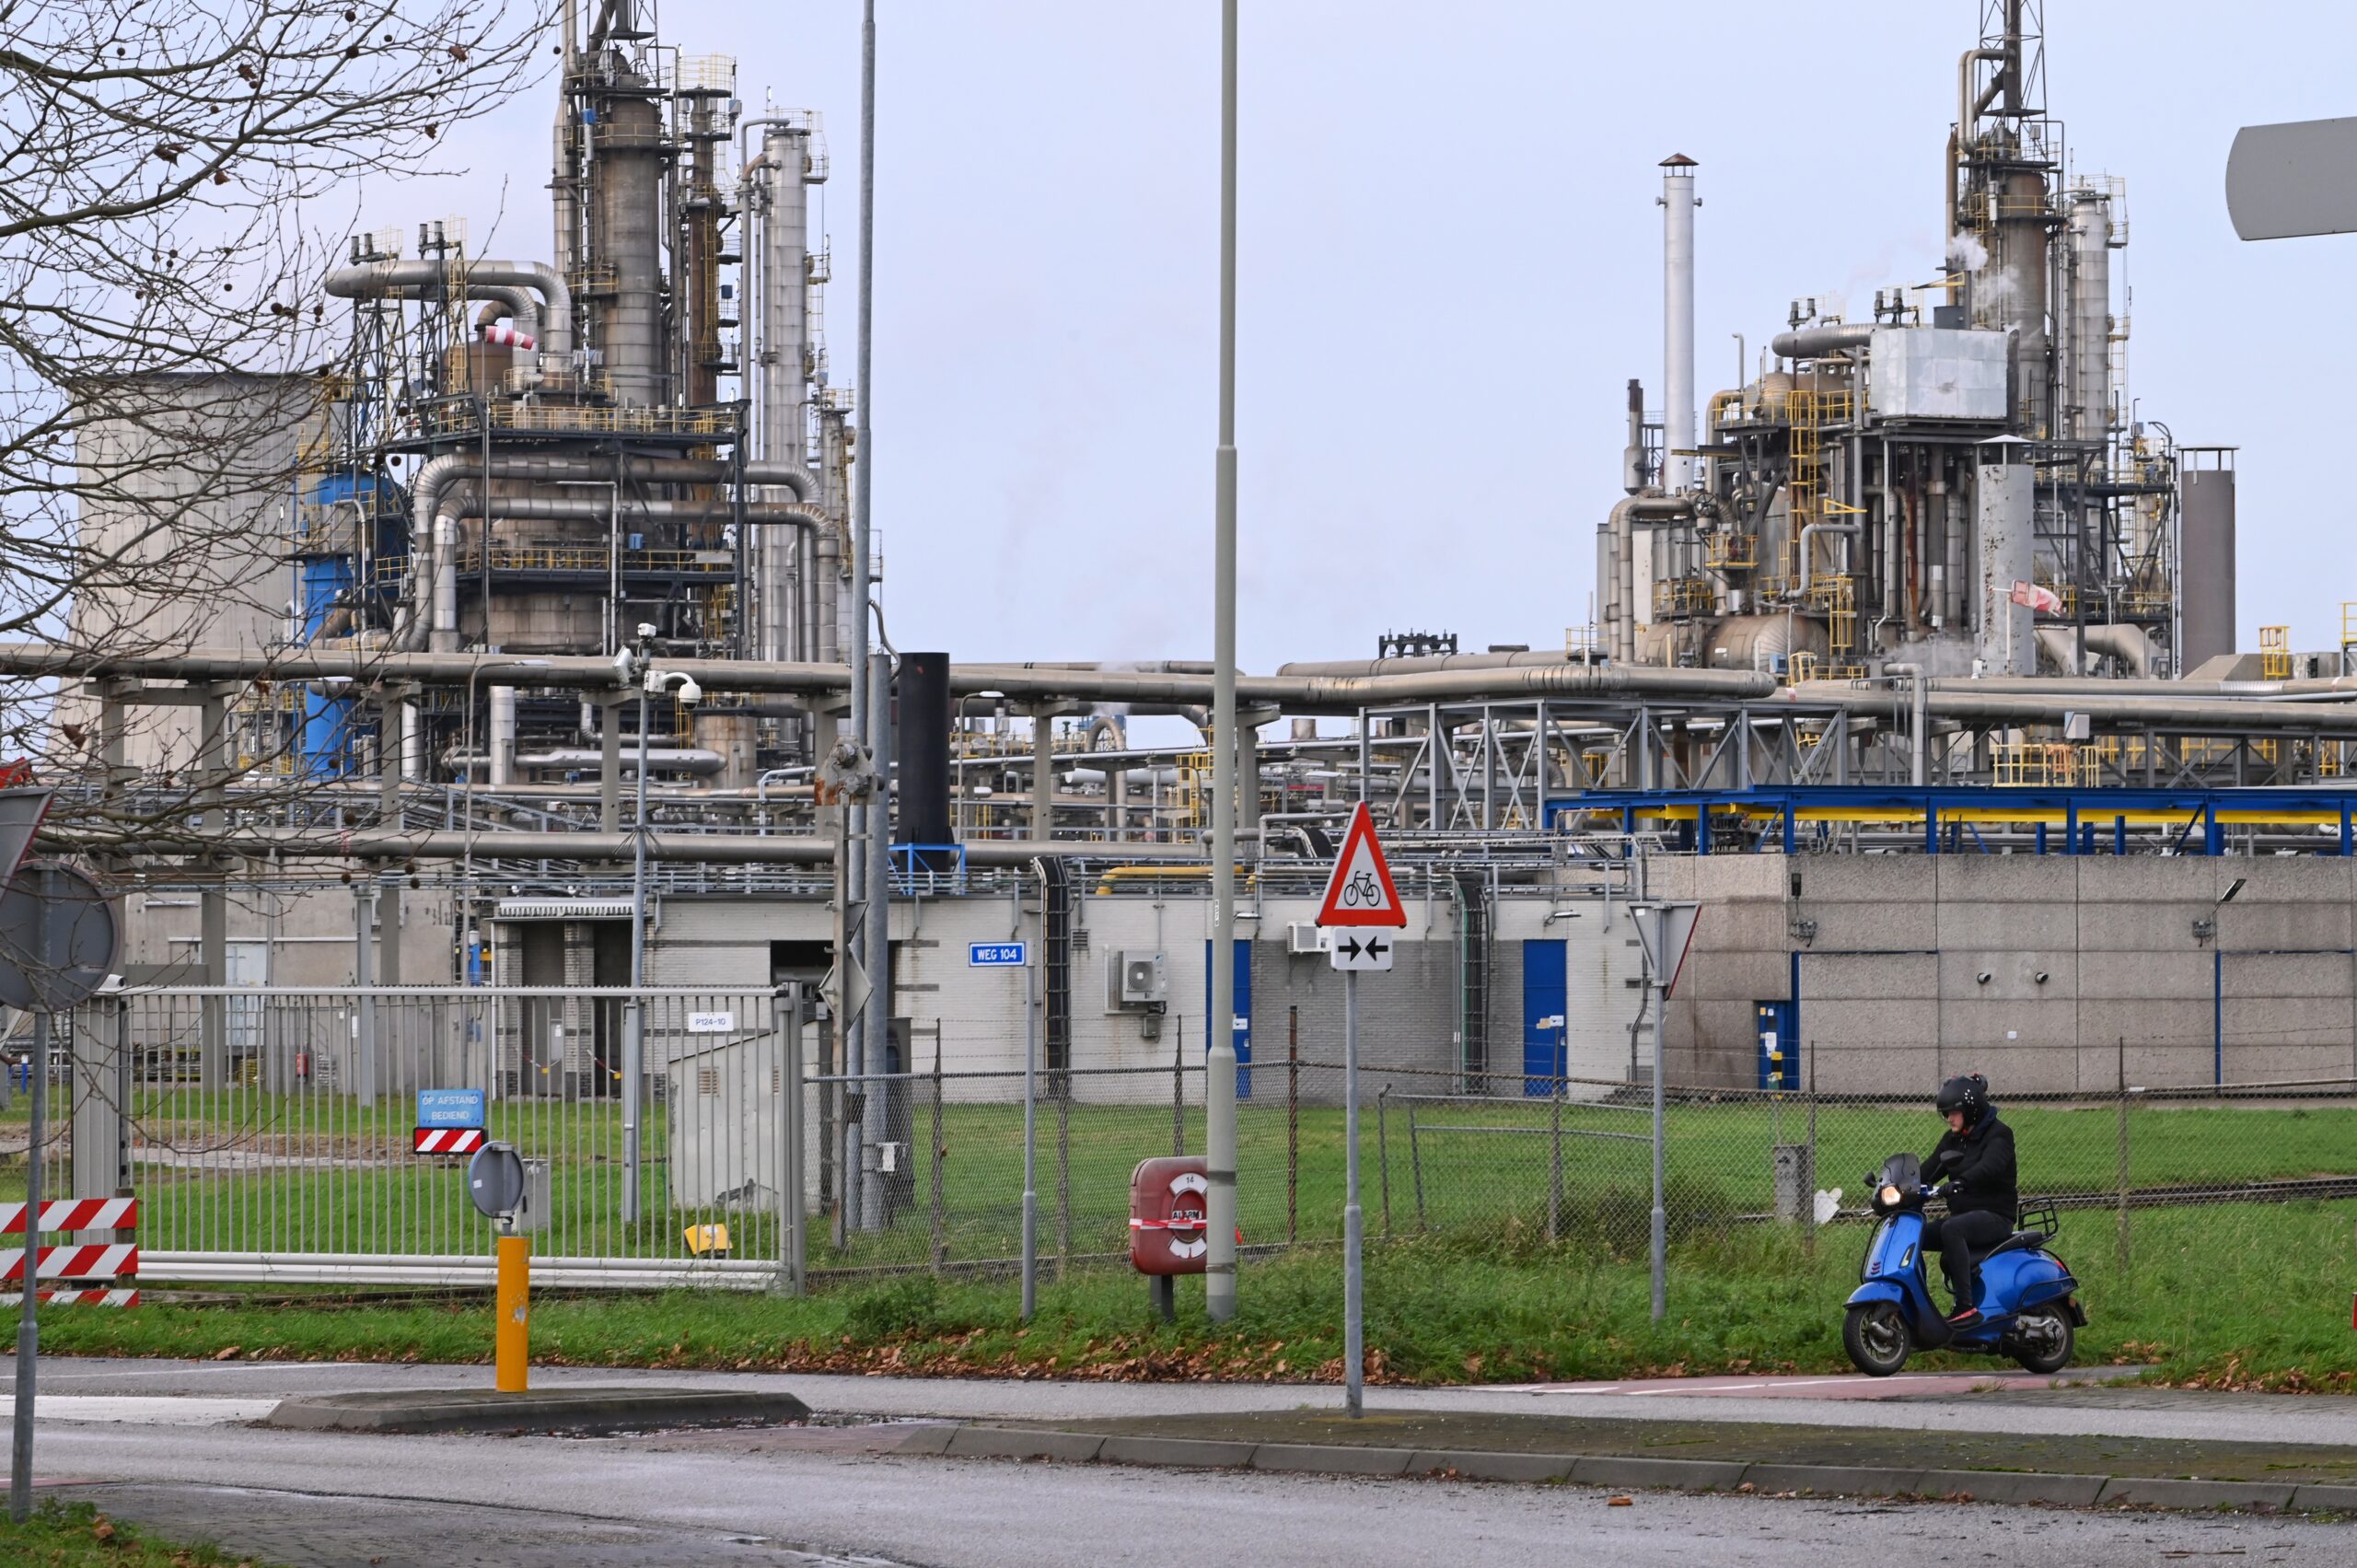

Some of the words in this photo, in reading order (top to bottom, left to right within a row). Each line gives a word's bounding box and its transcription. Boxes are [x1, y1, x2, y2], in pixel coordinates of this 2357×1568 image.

[977, 948, 997, 960] WEG
[1000, 948, 1016, 960] 104
[422, 1097, 435, 1105] OP
[437, 1096, 478, 1105] AFSTAND
[431, 1110, 470, 1121] BEDIEND
